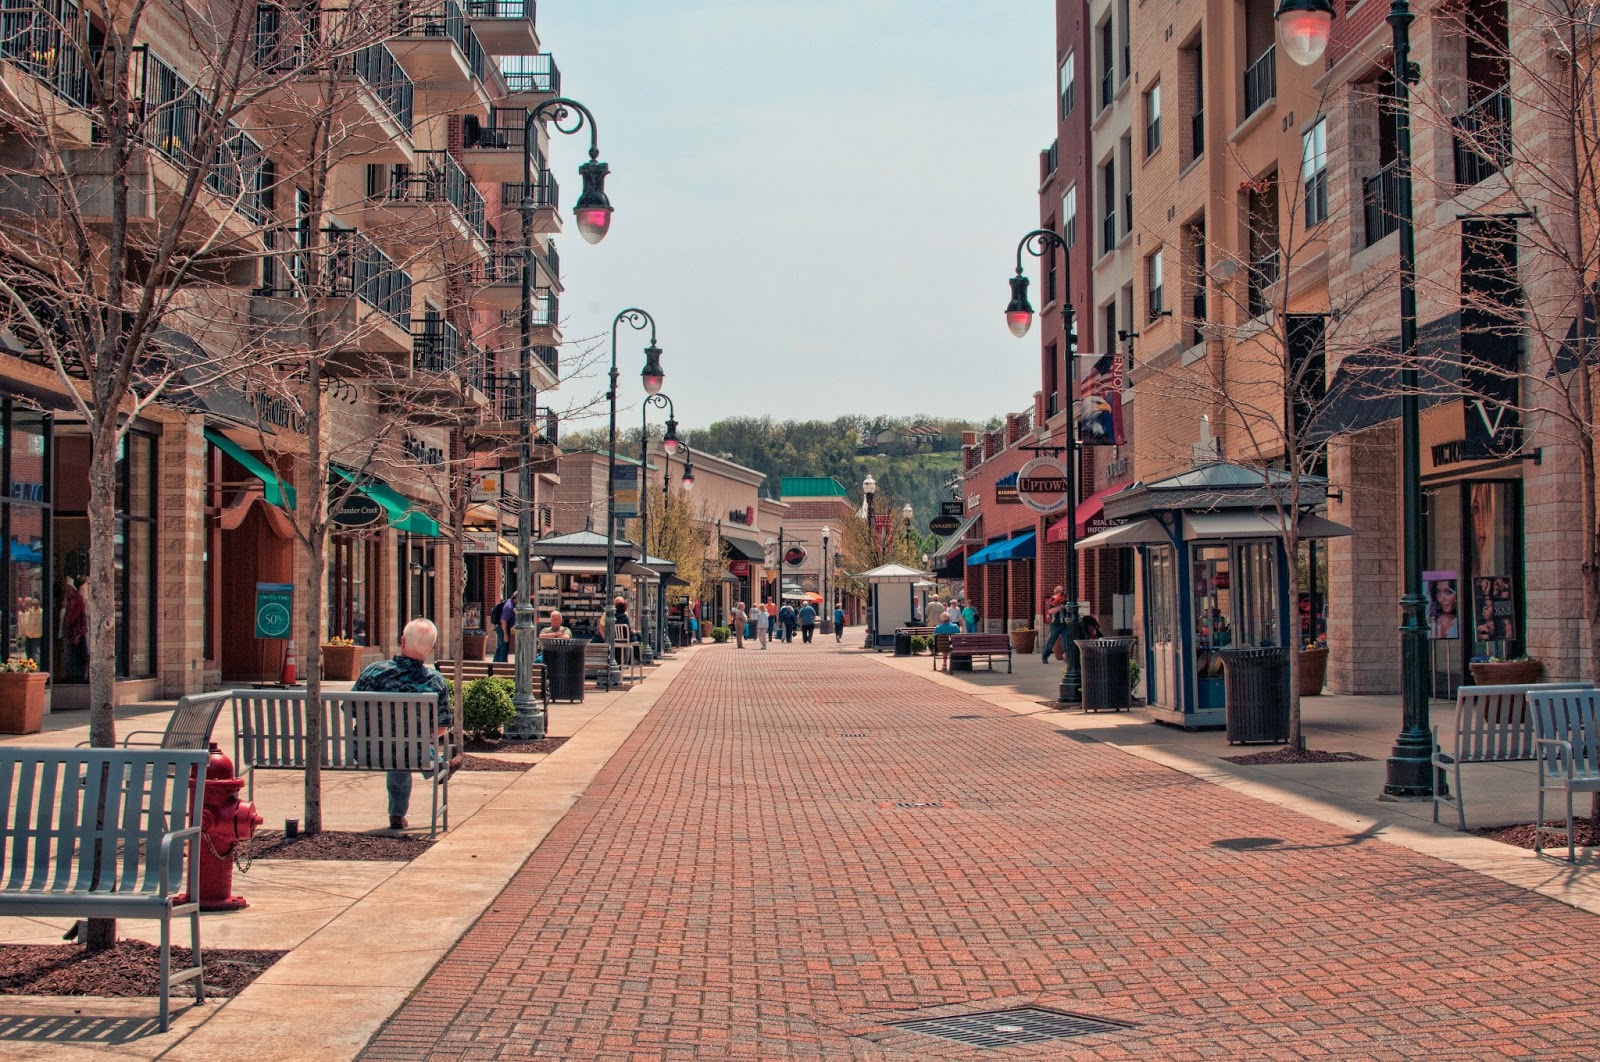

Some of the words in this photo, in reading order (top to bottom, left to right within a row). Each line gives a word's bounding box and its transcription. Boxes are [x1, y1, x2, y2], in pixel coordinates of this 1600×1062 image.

[1113, 356, 1123, 393] ENJOY
[1471, 400, 1511, 438] V
[1020, 478, 1067, 491] UPTOWN
[361, 506, 379, 514] Creek
[1109, 518, 1129, 526] ESTAT
[264, 613, 284, 625] 50%
